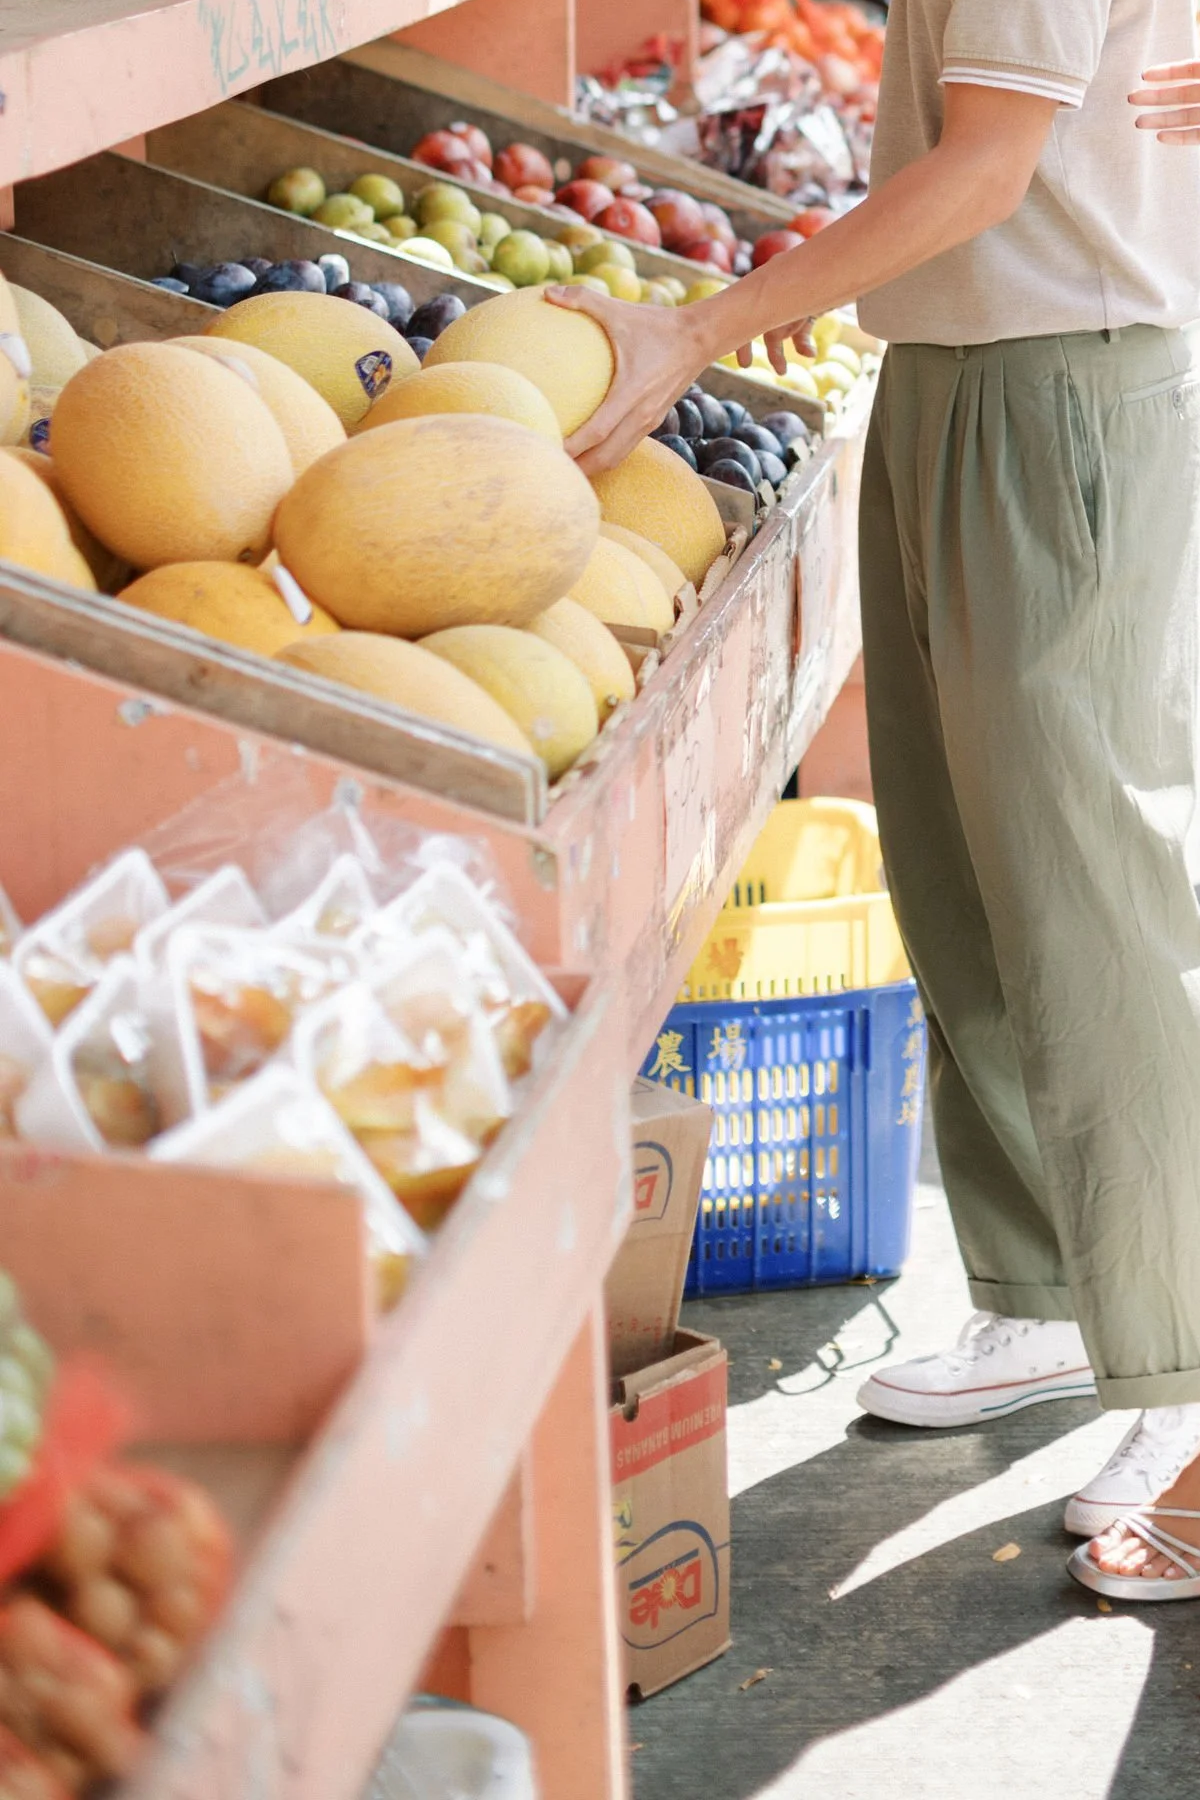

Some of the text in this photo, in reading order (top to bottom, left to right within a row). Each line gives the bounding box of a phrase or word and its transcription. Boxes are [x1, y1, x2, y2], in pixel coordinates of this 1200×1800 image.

[648, 1023, 747, 1078] 農場
[615, 1396, 723, 1469] PREMIUM BANANAS
[628, 1558, 703, 1629] Dole
